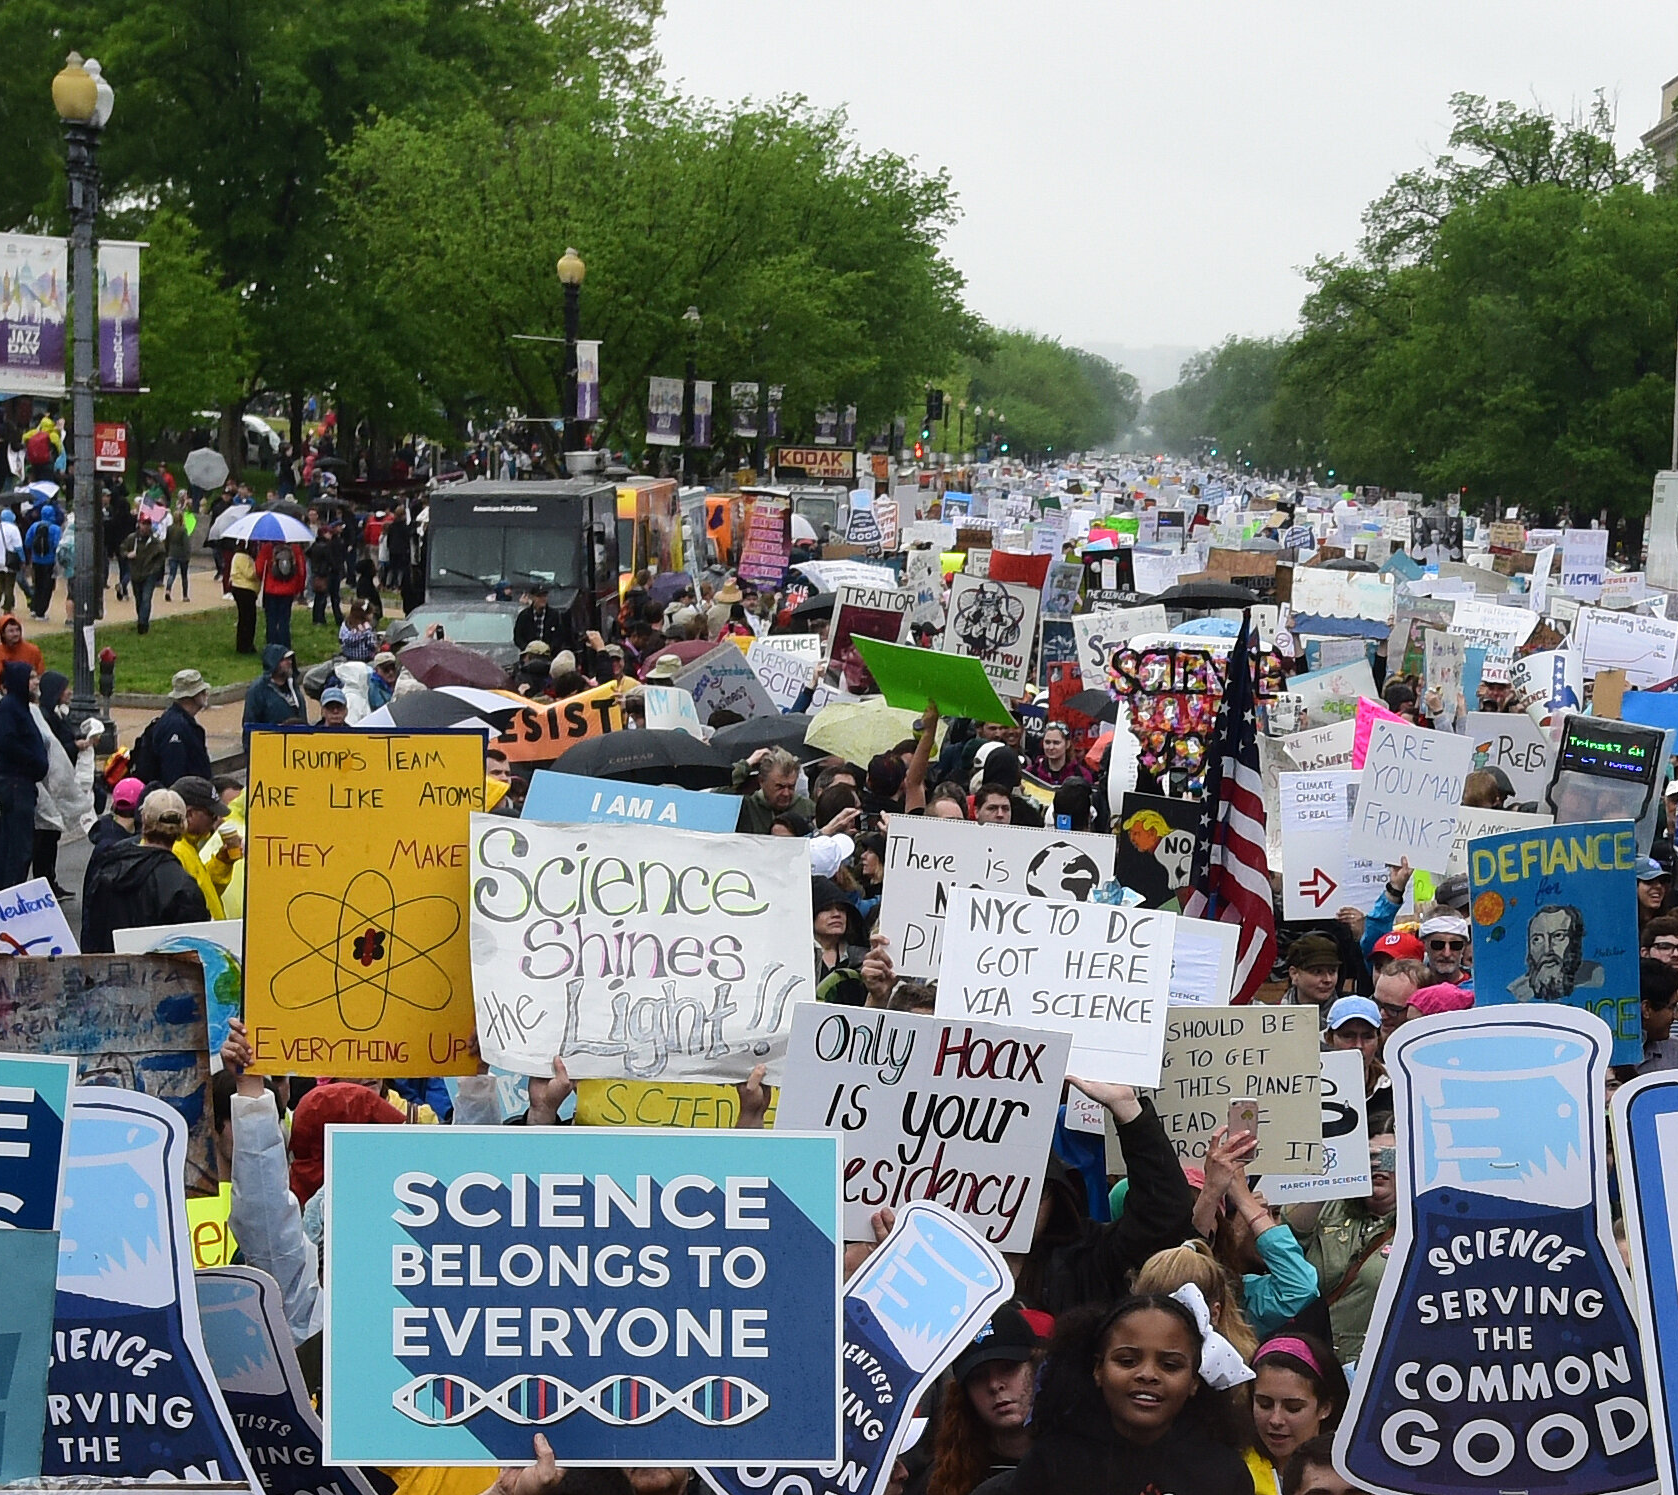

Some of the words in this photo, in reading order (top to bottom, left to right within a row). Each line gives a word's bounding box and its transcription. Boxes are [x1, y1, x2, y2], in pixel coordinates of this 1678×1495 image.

[780, 451, 842, 466] KODAK
[843, 586, 915, 611] TRAITOR
[1587, 610, 1634, 633] Spending
[368, 735, 445, 770] TEAM
[250, 783, 299, 809] ARE
[329, 787, 384, 810] LIKE
[419, 783, 485, 808] ATOMS
[1296, 780, 1333, 790] CLIMATE
[1296, 793, 1336, 802] CHANGE
[1372, 764, 1413, 794] YOU
[1421, 774, 1461, 801] MAD
[255, 835, 335, 868] THEY
[389, 839, 469, 869] MAKE
[1473, 832, 1635, 886] DEFIANCE
[473, 826, 769, 922] Science
[970, 900, 1032, 935] NYC
[1040, 905, 1080, 936] TO
[1106, 912, 1153, 949] DC
[520, 917, 748, 981] Shines
[977, 948, 1038, 977] GOT
[1065, 951, 1149, 984] HERE
[482, 992, 549, 1048] the
[963, 986, 1012, 1017] VIA
[1032, 994, 1153, 1025] SCIENCE
[254, 1027, 409, 1063] EVERYTHING
[428, 1030, 467, 1063] UP
[815, 1014, 916, 1085] Only
[934, 1026, 1046, 1084] Hoax
[901, 1093, 1028, 1164] your
[391, 1171, 770, 1230] SCIENCE
[391, 1244, 669, 1288] BELONGS
[688, 1245, 766, 1289] TO
[1428, 1228, 1585, 1275] SCIENCE
[1417, 1283, 1604, 1321] SERVING
[392, 1307, 769, 1358] EVERYONE
[1475, 1326, 1533, 1351] THE
[1395, 1346, 1634, 1402] COMMON
[1381, 1396, 1649, 1476] GOOD
